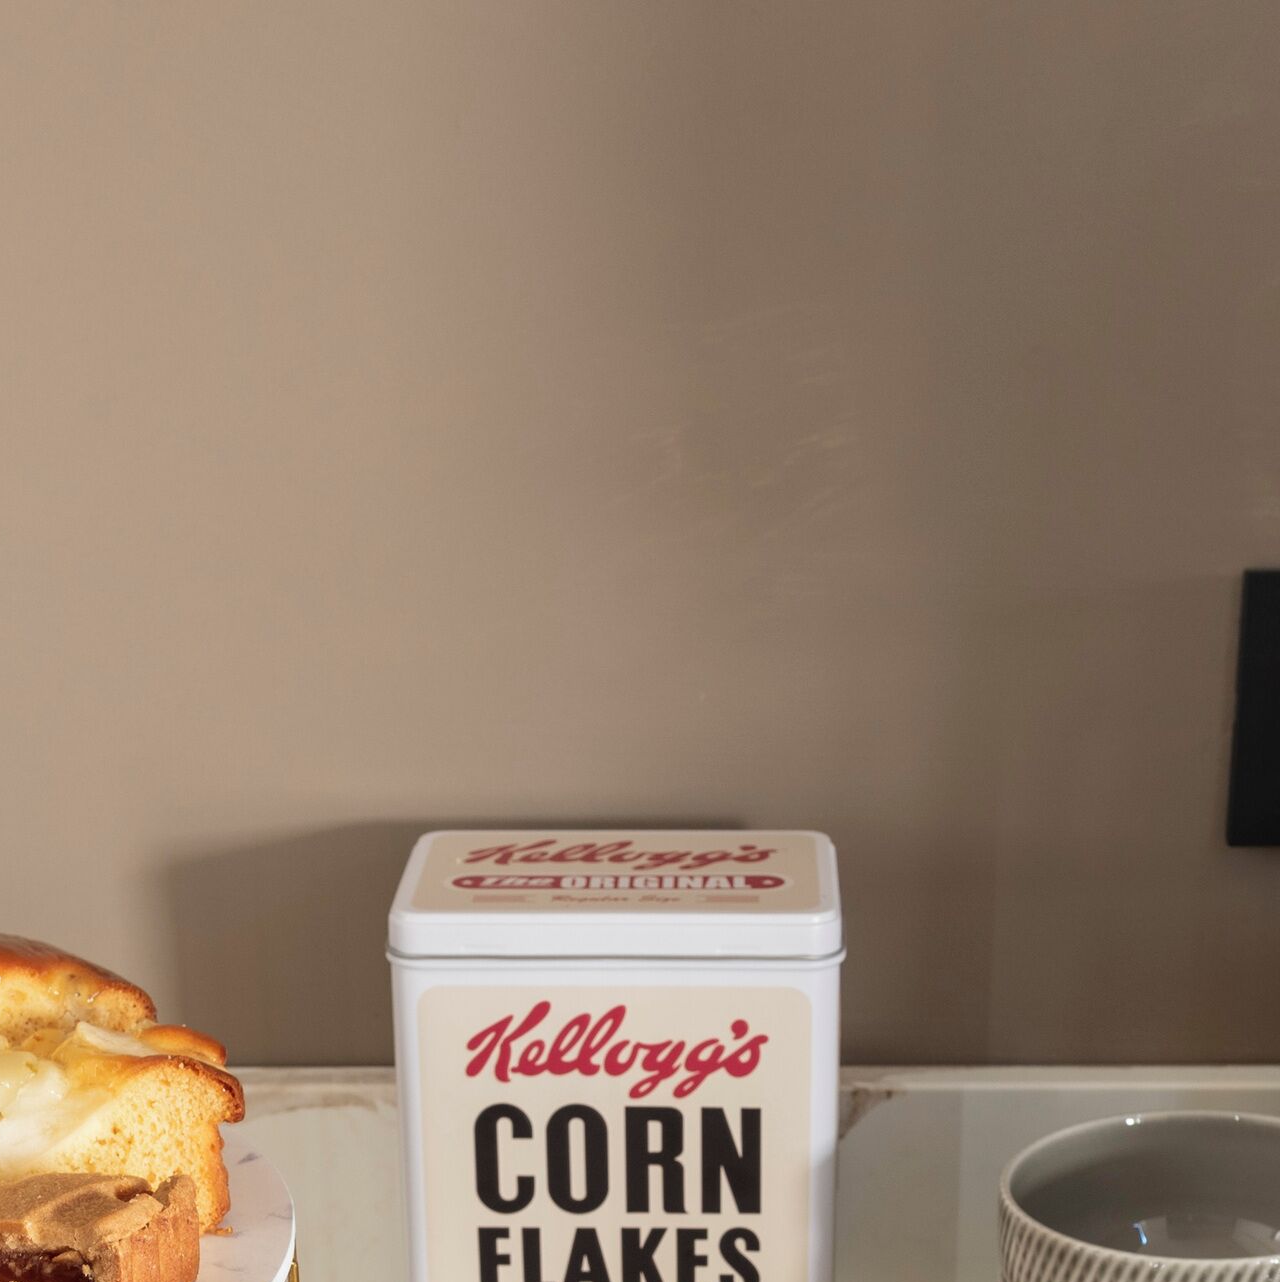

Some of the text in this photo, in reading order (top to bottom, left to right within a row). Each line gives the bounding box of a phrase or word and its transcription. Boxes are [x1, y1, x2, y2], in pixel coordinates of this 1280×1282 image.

[464, 840, 776, 870] Kellogg's
[560, 876, 752, 889] ORIGINAL
[466, 1001, 768, 1099] Kellogg's
[475, 1104, 760, 1213] CORN
